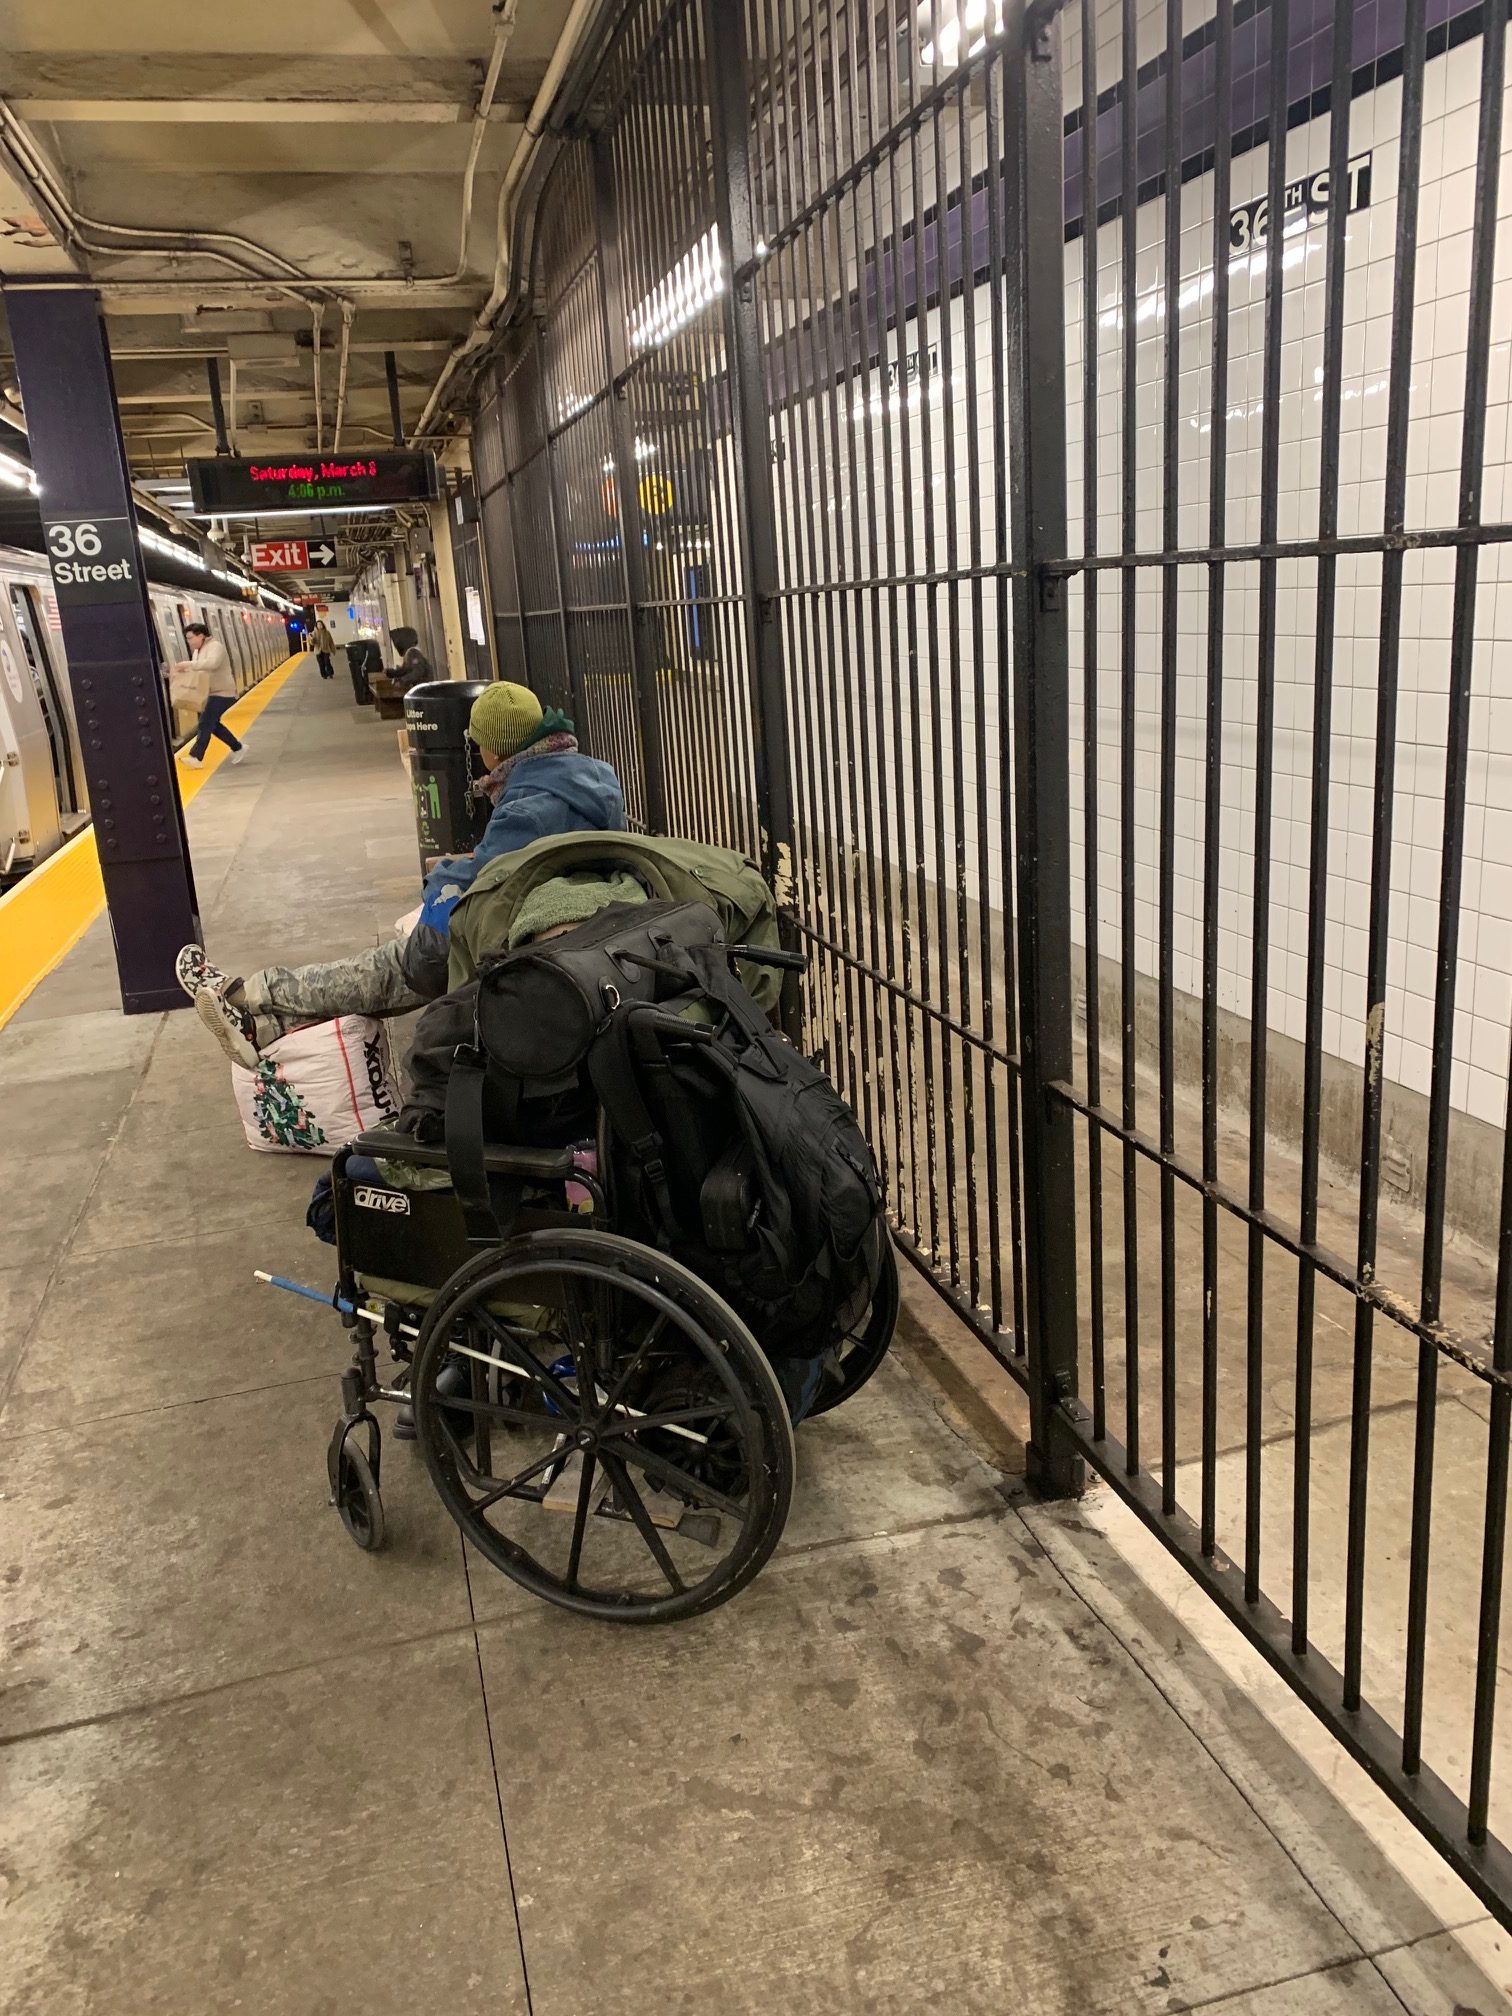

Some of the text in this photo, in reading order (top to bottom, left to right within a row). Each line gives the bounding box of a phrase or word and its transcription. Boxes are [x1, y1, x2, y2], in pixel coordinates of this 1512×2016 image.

[1309, 153, 1371, 224] ST
[250, 460, 377, 482] Saturday, March 8
[316, 484, 346, 499] p.m.
[49, 523, 102, 558] 36
[251, 542, 302, 568] Exit
[54, 558, 132, 584] Street
[416, 721, 439, 731] Here
[356, 1187, 407, 1213] drive
